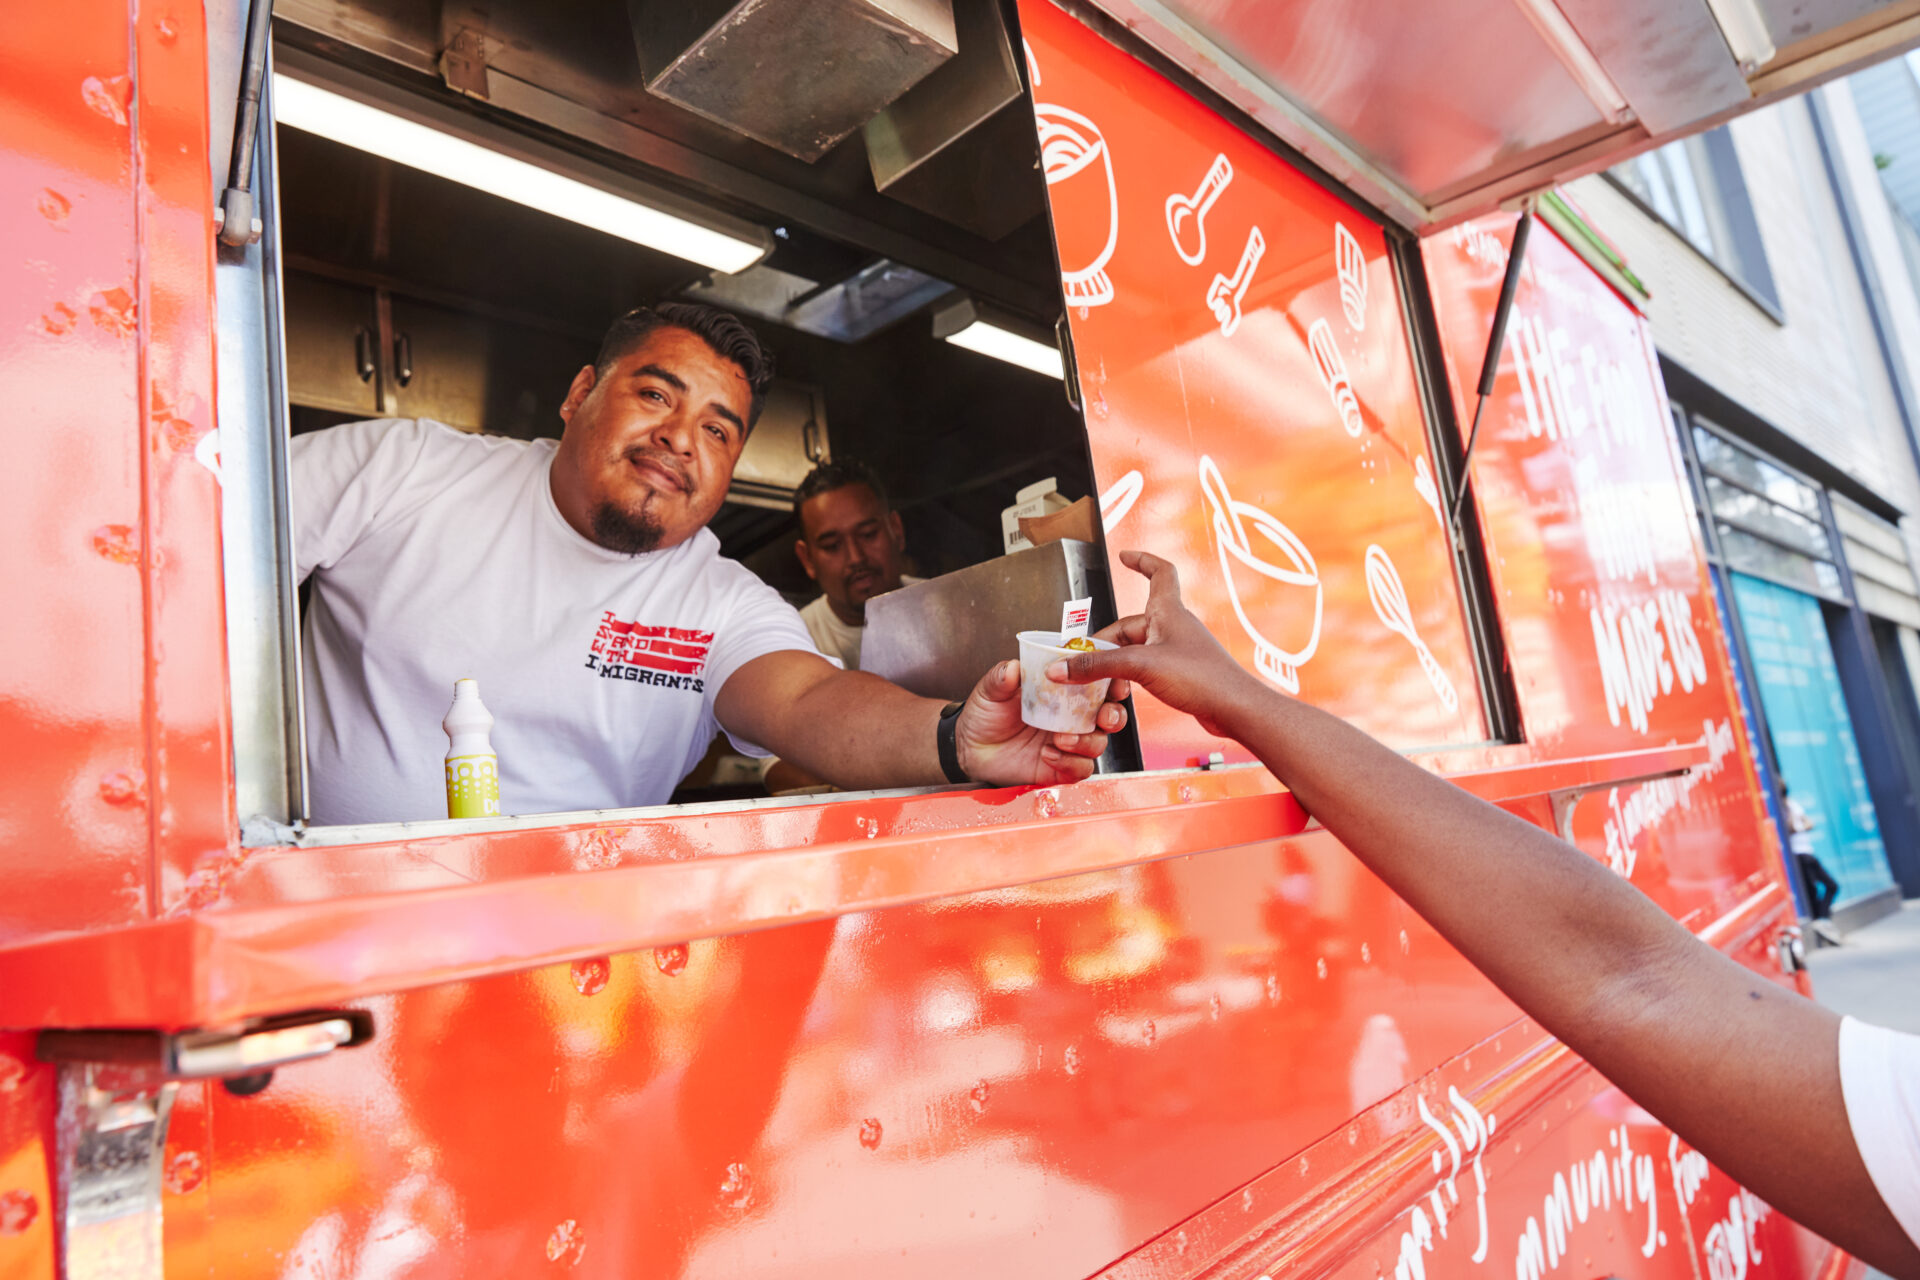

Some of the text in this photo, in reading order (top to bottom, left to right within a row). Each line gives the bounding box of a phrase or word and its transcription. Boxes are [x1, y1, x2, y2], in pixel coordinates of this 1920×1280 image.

[1505, 302, 1588, 441] THE
[590, 638, 634, 664] WTH
[597, 626, 650, 650] SAND
[585, 655, 704, 693] IMIGRANTS
[1590, 600, 1673, 734] MADE
[1658, 590, 1708, 694] US
